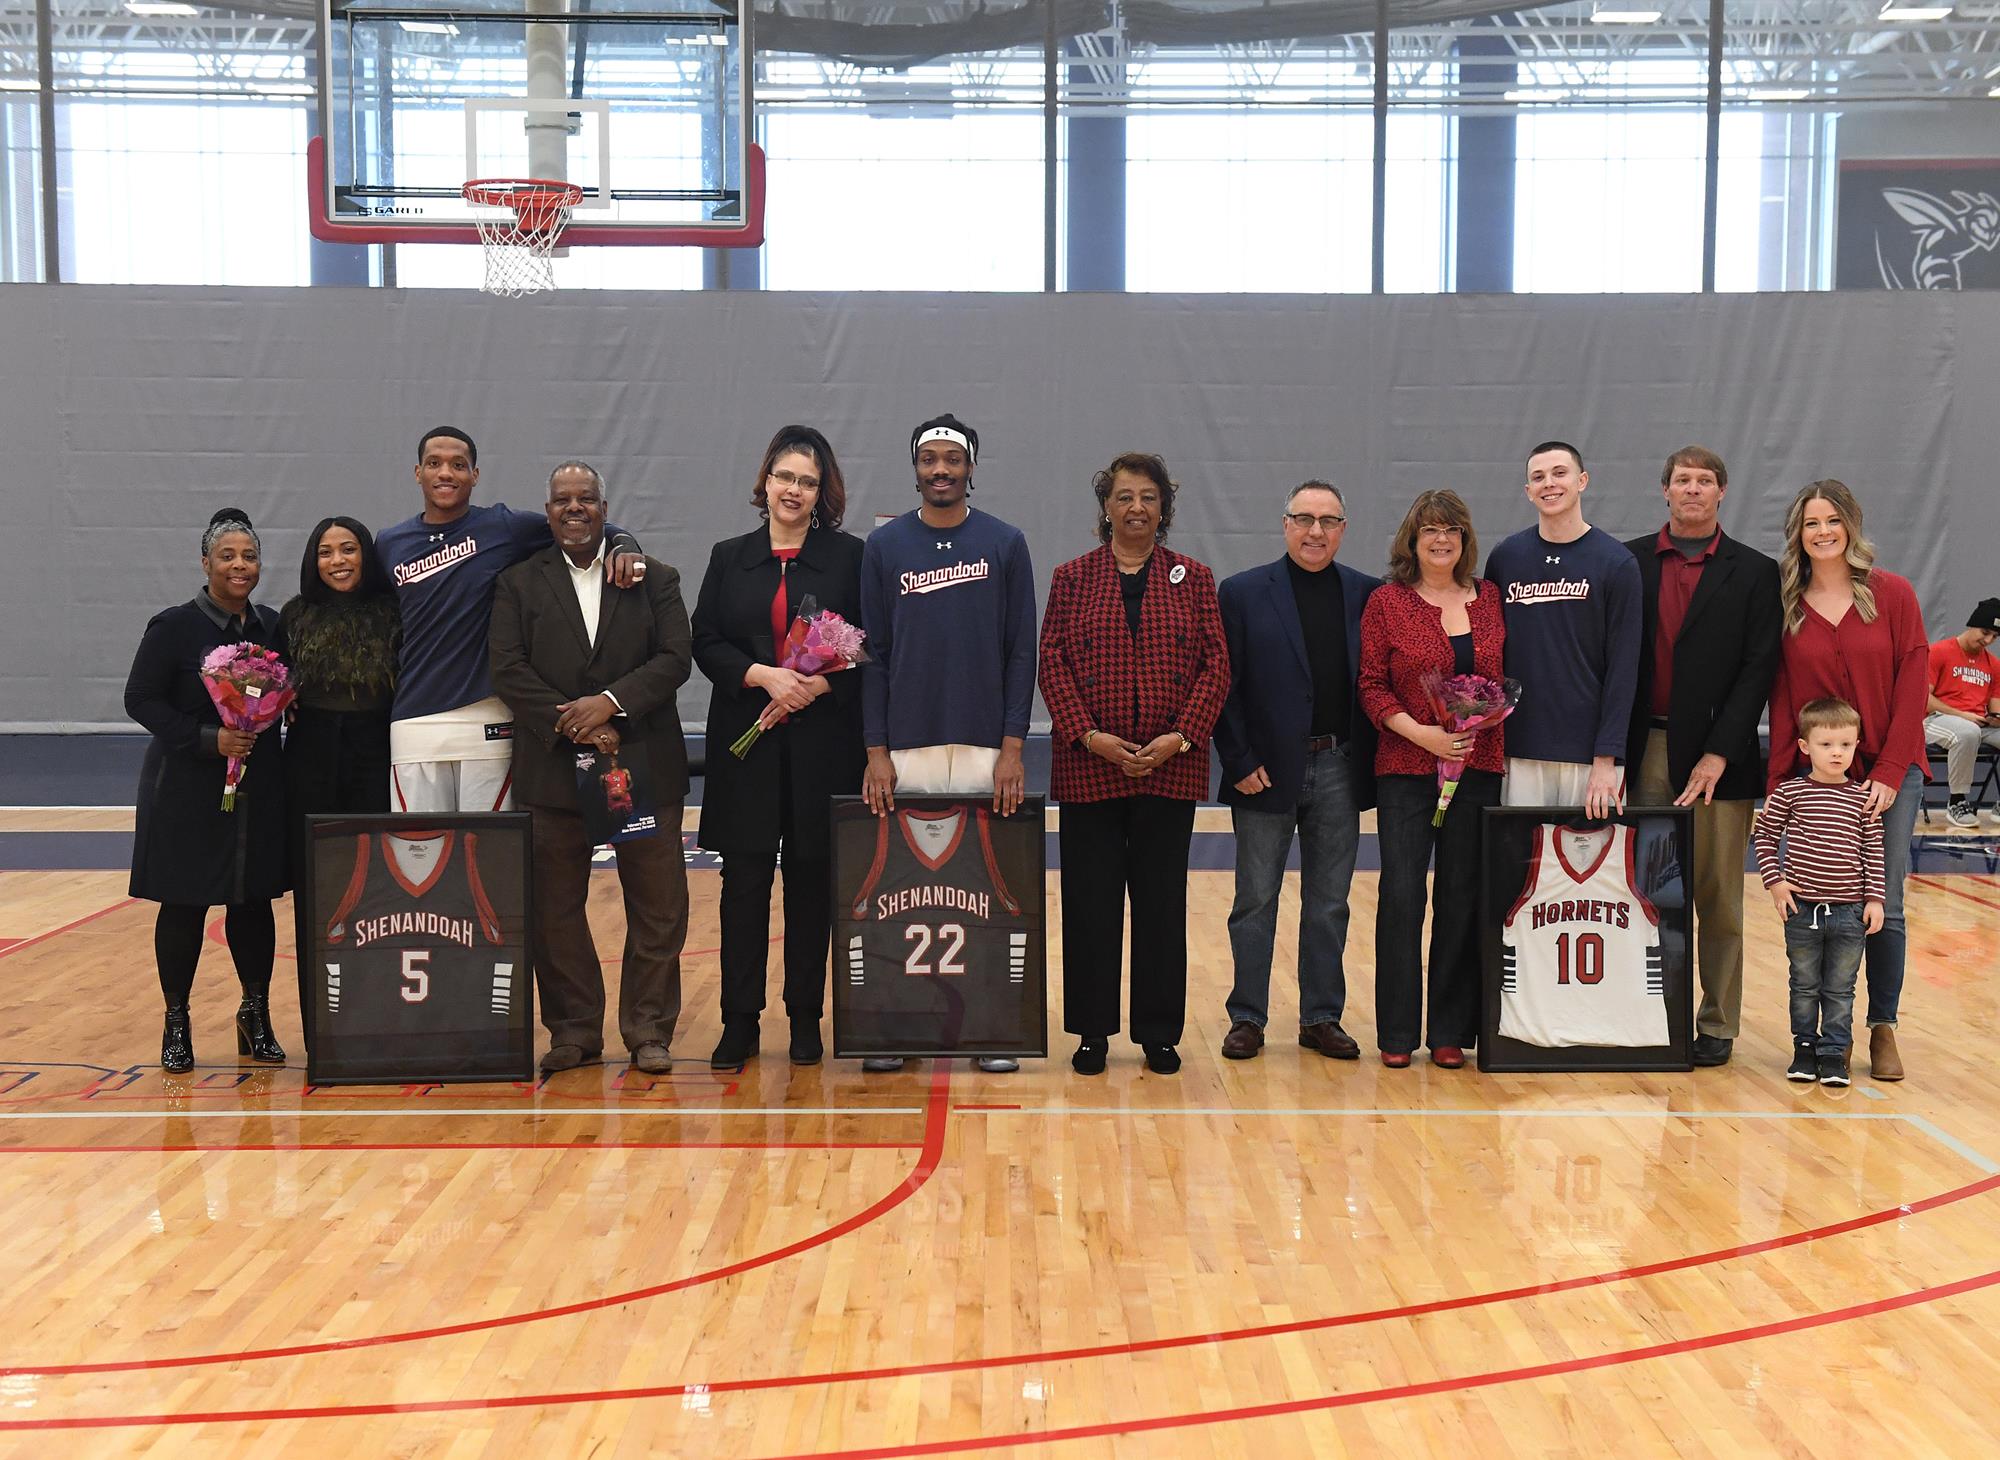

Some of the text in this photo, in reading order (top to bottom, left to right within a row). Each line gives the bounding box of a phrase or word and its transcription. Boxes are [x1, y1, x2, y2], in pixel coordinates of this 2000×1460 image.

[393, 536, 477, 587] Shenandoah
[900, 558, 989, 595] Shenandoah
[1505, 577, 1590, 603] Shenandoah
[1953, 666, 1991, 683] SHNANDOA
[877, 885, 989, 921] SHENANDOAH
[1532, 899, 1630, 930] HORNETS
[355, 911, 473, 949] SHENANDOAH
[905, 923, 966, 975] 22
[1555, 932, 1604, 985] 10
[401, 949, 431, 1003] 5
